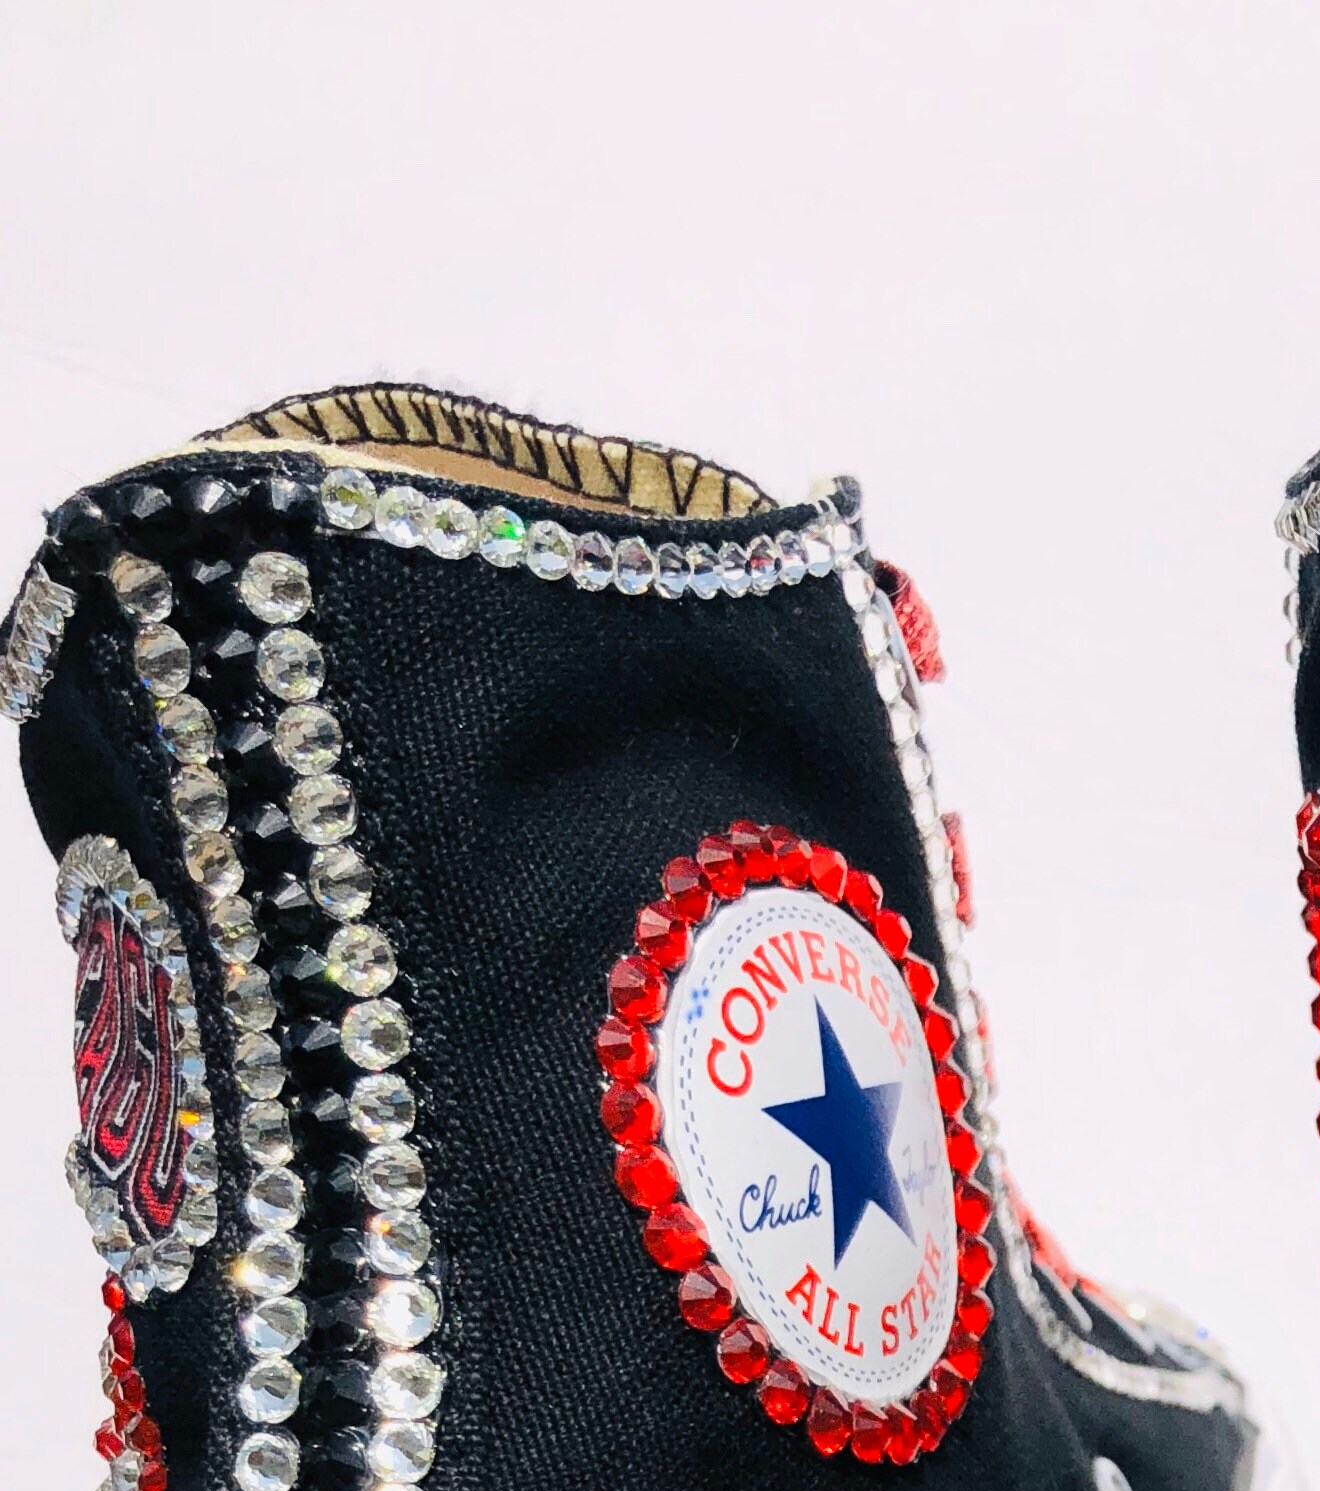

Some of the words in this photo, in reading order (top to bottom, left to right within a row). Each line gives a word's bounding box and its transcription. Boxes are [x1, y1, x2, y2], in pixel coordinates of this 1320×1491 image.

[705, 928, 910, 1098] CONVERSE
[739, 1162, 823, 1234] Chuck
[785, 1262, 865, 1358] ALL
[882, 1230, 943, 1357] STAR
